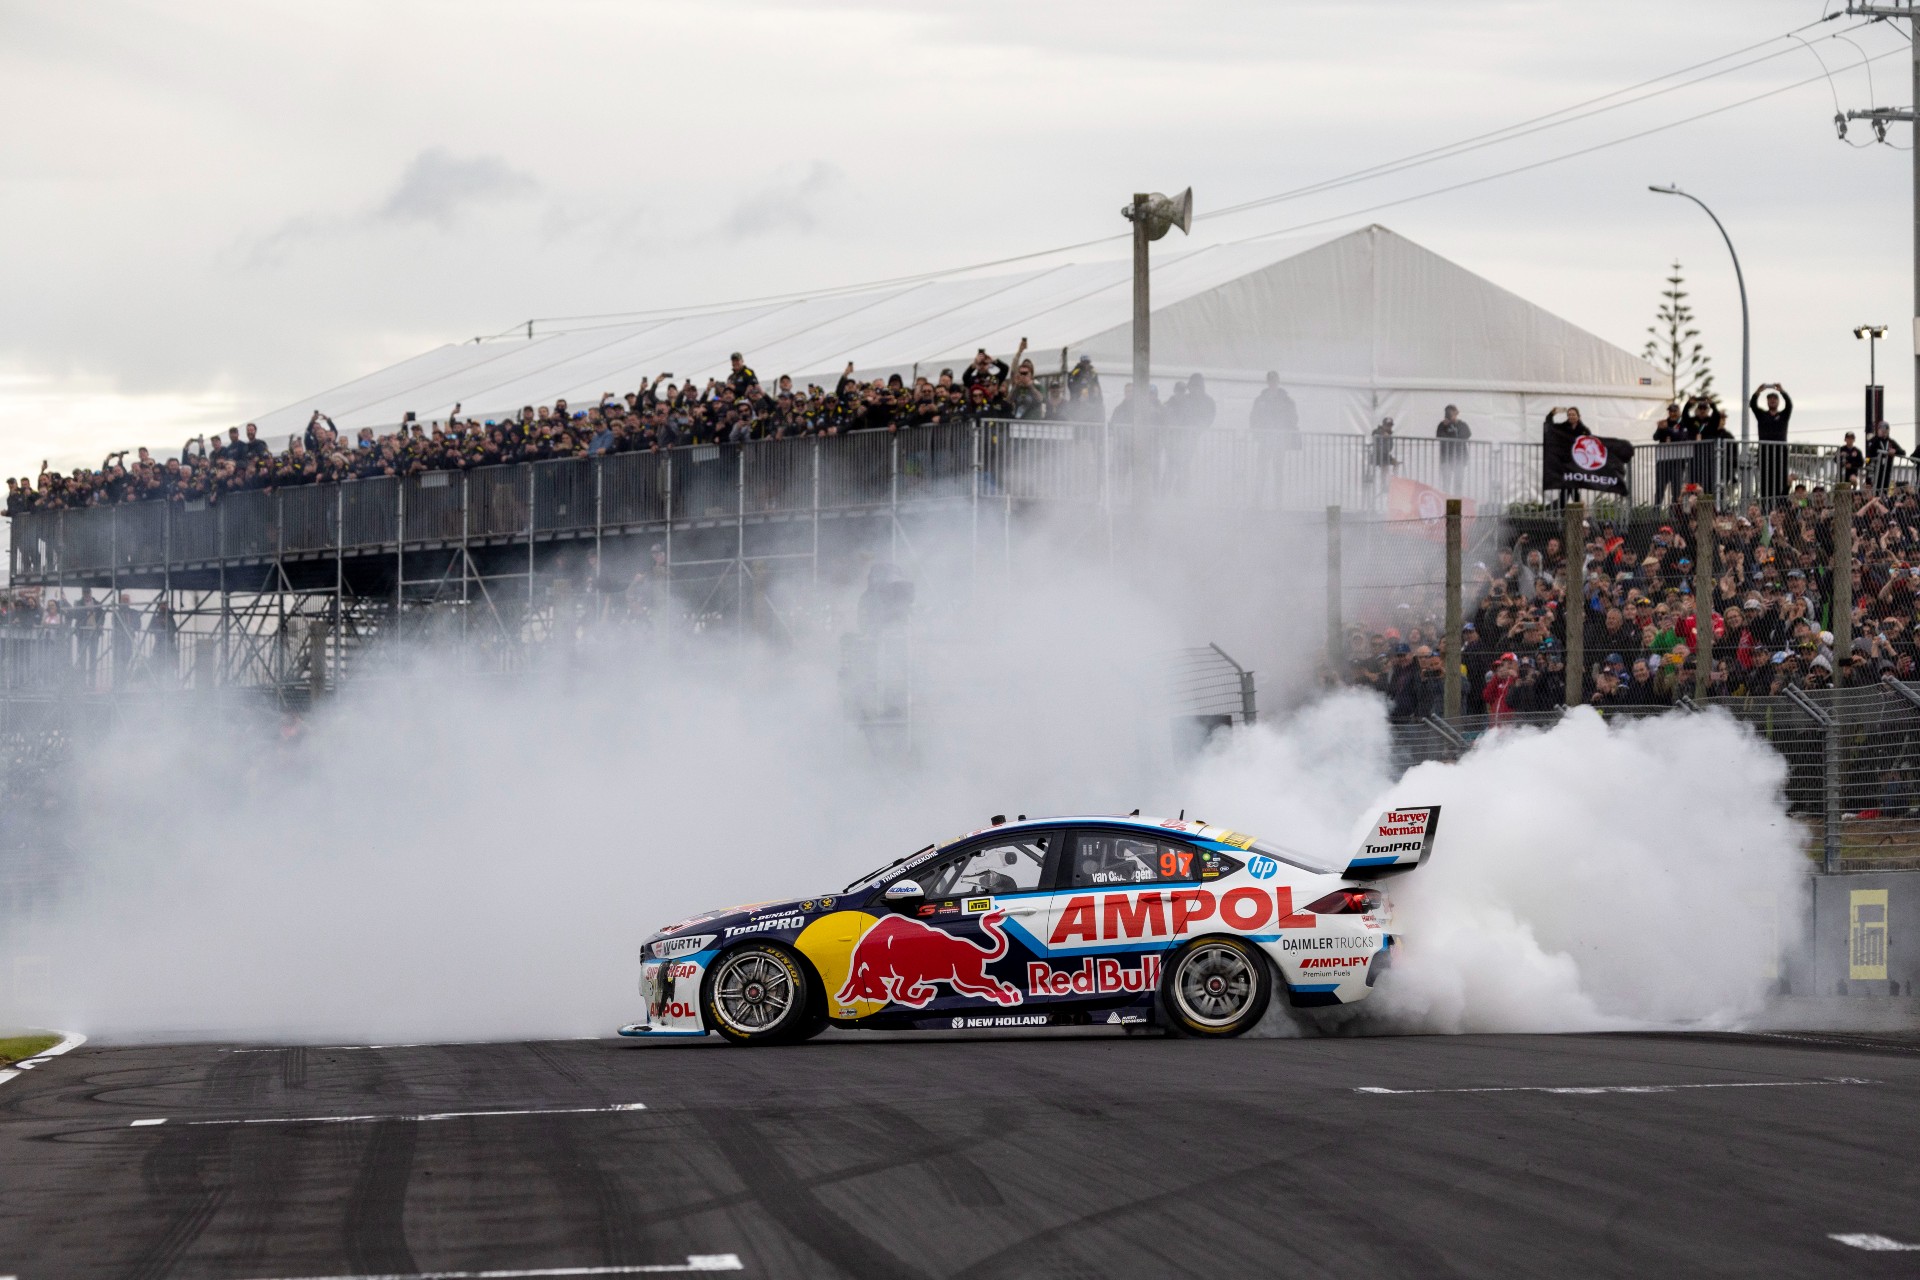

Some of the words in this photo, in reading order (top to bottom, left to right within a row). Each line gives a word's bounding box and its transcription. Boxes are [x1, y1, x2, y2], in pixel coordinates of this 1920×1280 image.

[1563, 472, 1618, 485] HOLDEN
[1387, 812, 1428, 823] Harvey
[1379, 826, 1424, 837] Norman
[1365, 841, 1421, 854] ToolPRO
[1160, 852, 1194, 877] 97
[1252, 857, 1274, 880] hp
[881, 867, 907, 883] THANKS
[1092, 872, 1108, 883] van
[757, 909, 799, 921] DUNLOP
[1049, 886, 1316, 944] AMPOL
[723, 915, 805, 938] ToolPRO
[663, 938, 702, 956] WÜRTH
[1282, 938, 1333, 951] DAIMLER
[1335, 936, 1374, 949] TRUCKS
[766, 947, 801, 987] DUNLOP
[1310, 956, 1369, 968] AMPLIFY
[1027, 957, 1094, 996] Red
[1096, 954, 1161, 993] Bull
[1303, 970, 1332, 978] Premium
[1333, 970, 1351, 978] Fuels
[967, 1018, 993, 1028] NEW
[995, 1015, 1047, 1026] HOLLAND
